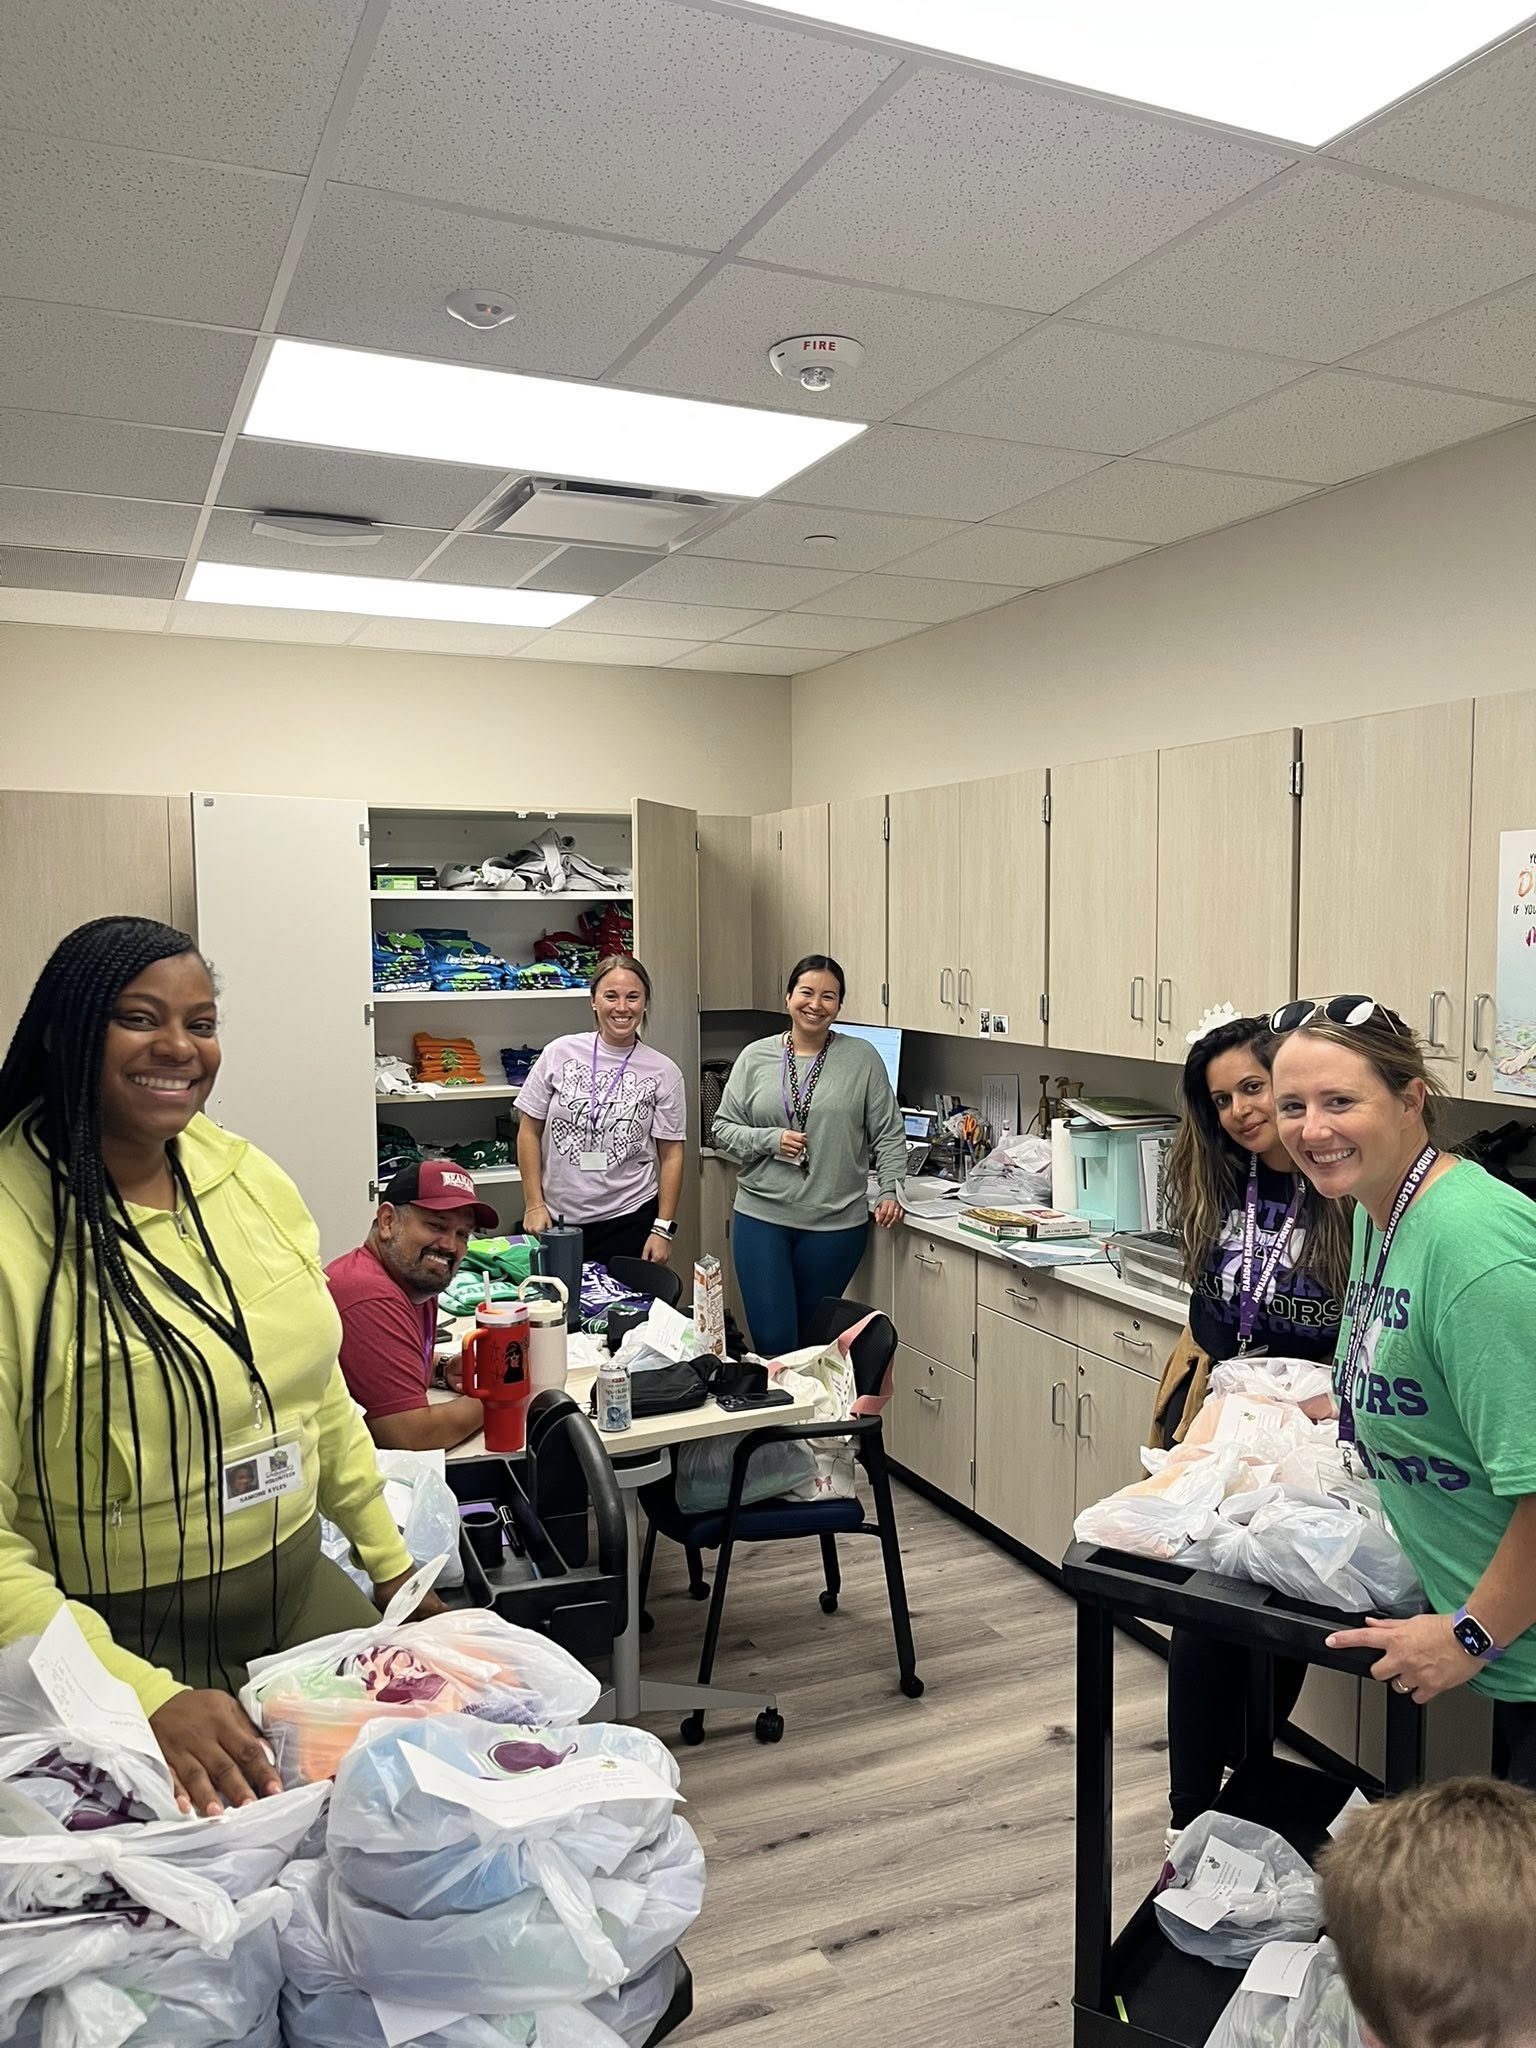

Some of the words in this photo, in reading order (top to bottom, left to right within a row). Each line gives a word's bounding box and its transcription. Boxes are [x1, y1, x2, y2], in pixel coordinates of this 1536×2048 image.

[803, 341, 837, 351] FIRE
[1513, 905, 1519, 915] IF
[268, 1483, 287, 1494] KYLES
